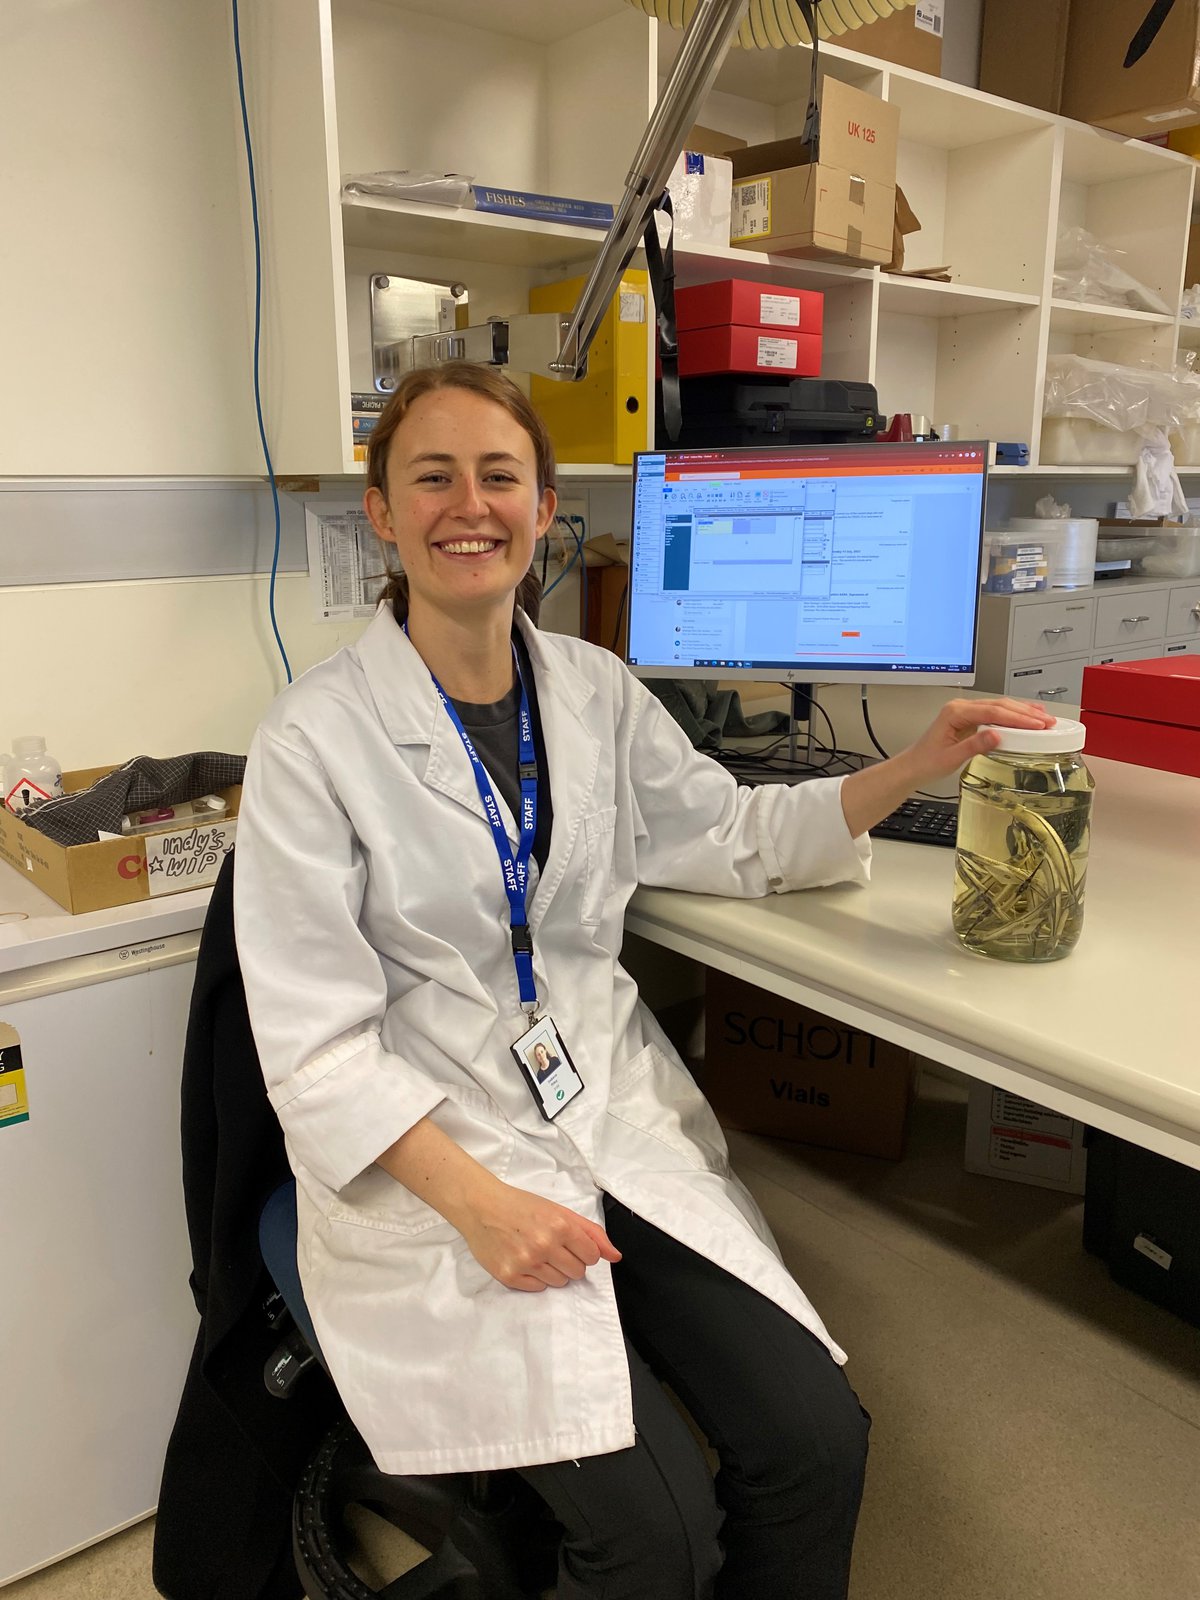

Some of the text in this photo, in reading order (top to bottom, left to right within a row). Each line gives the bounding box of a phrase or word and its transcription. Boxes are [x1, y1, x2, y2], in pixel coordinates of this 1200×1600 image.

[848, 121, 876, 144] UK 125
[486, 191, 526, 208] FISHES
[521, 710, 531, 742] STAFF
[461, 732, 480, 763] STAFF
[485, 795, 501, 828] STAFF
[524, 797, 534, 830] STAFF
[166, 852, 218, 877] WIP
[503, 858, 518, 891] STAFF
[131, 943, 166, 956] Westinghouse
[769, 1078, 831, 1108] Vials
